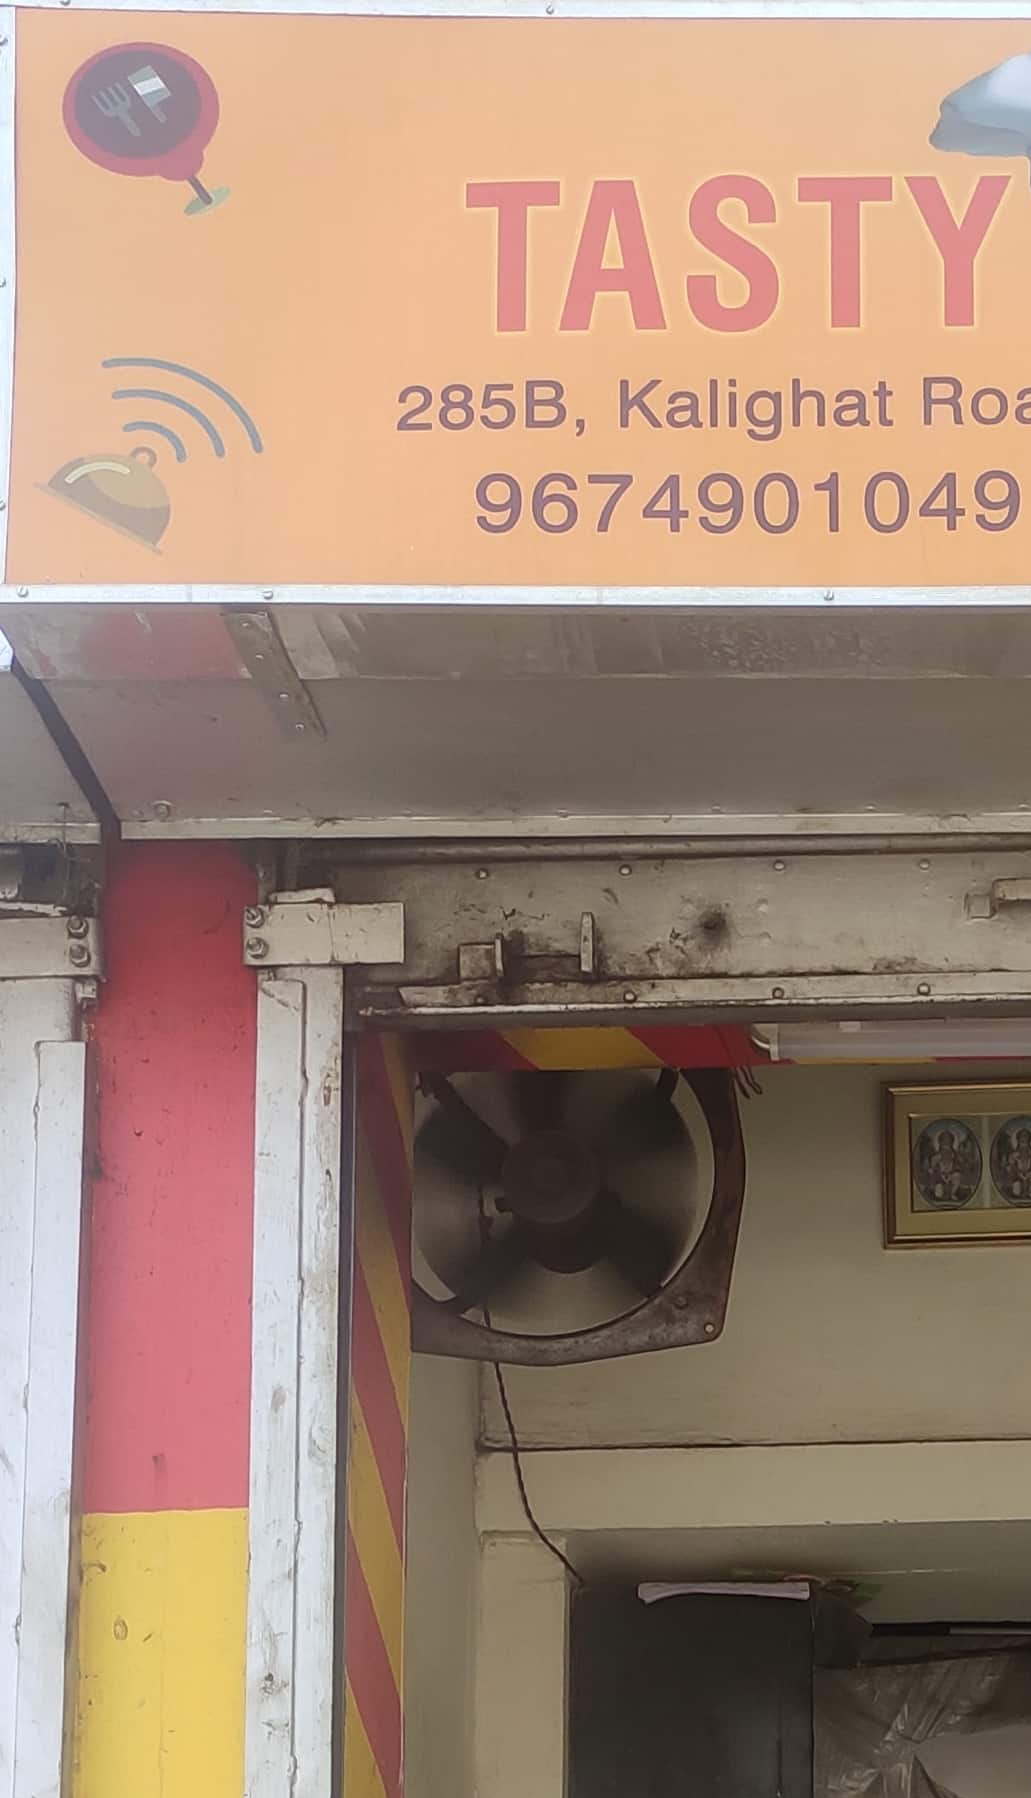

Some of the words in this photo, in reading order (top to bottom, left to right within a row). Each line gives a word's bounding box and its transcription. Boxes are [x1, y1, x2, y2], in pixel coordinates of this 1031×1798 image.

[465, 173, 1012, 334] TASTY
[397, 382, 587, 439] 285B,
[617, 377, 894, 441] Kalighat
[475, 469, 1021, 536] 9674901049
